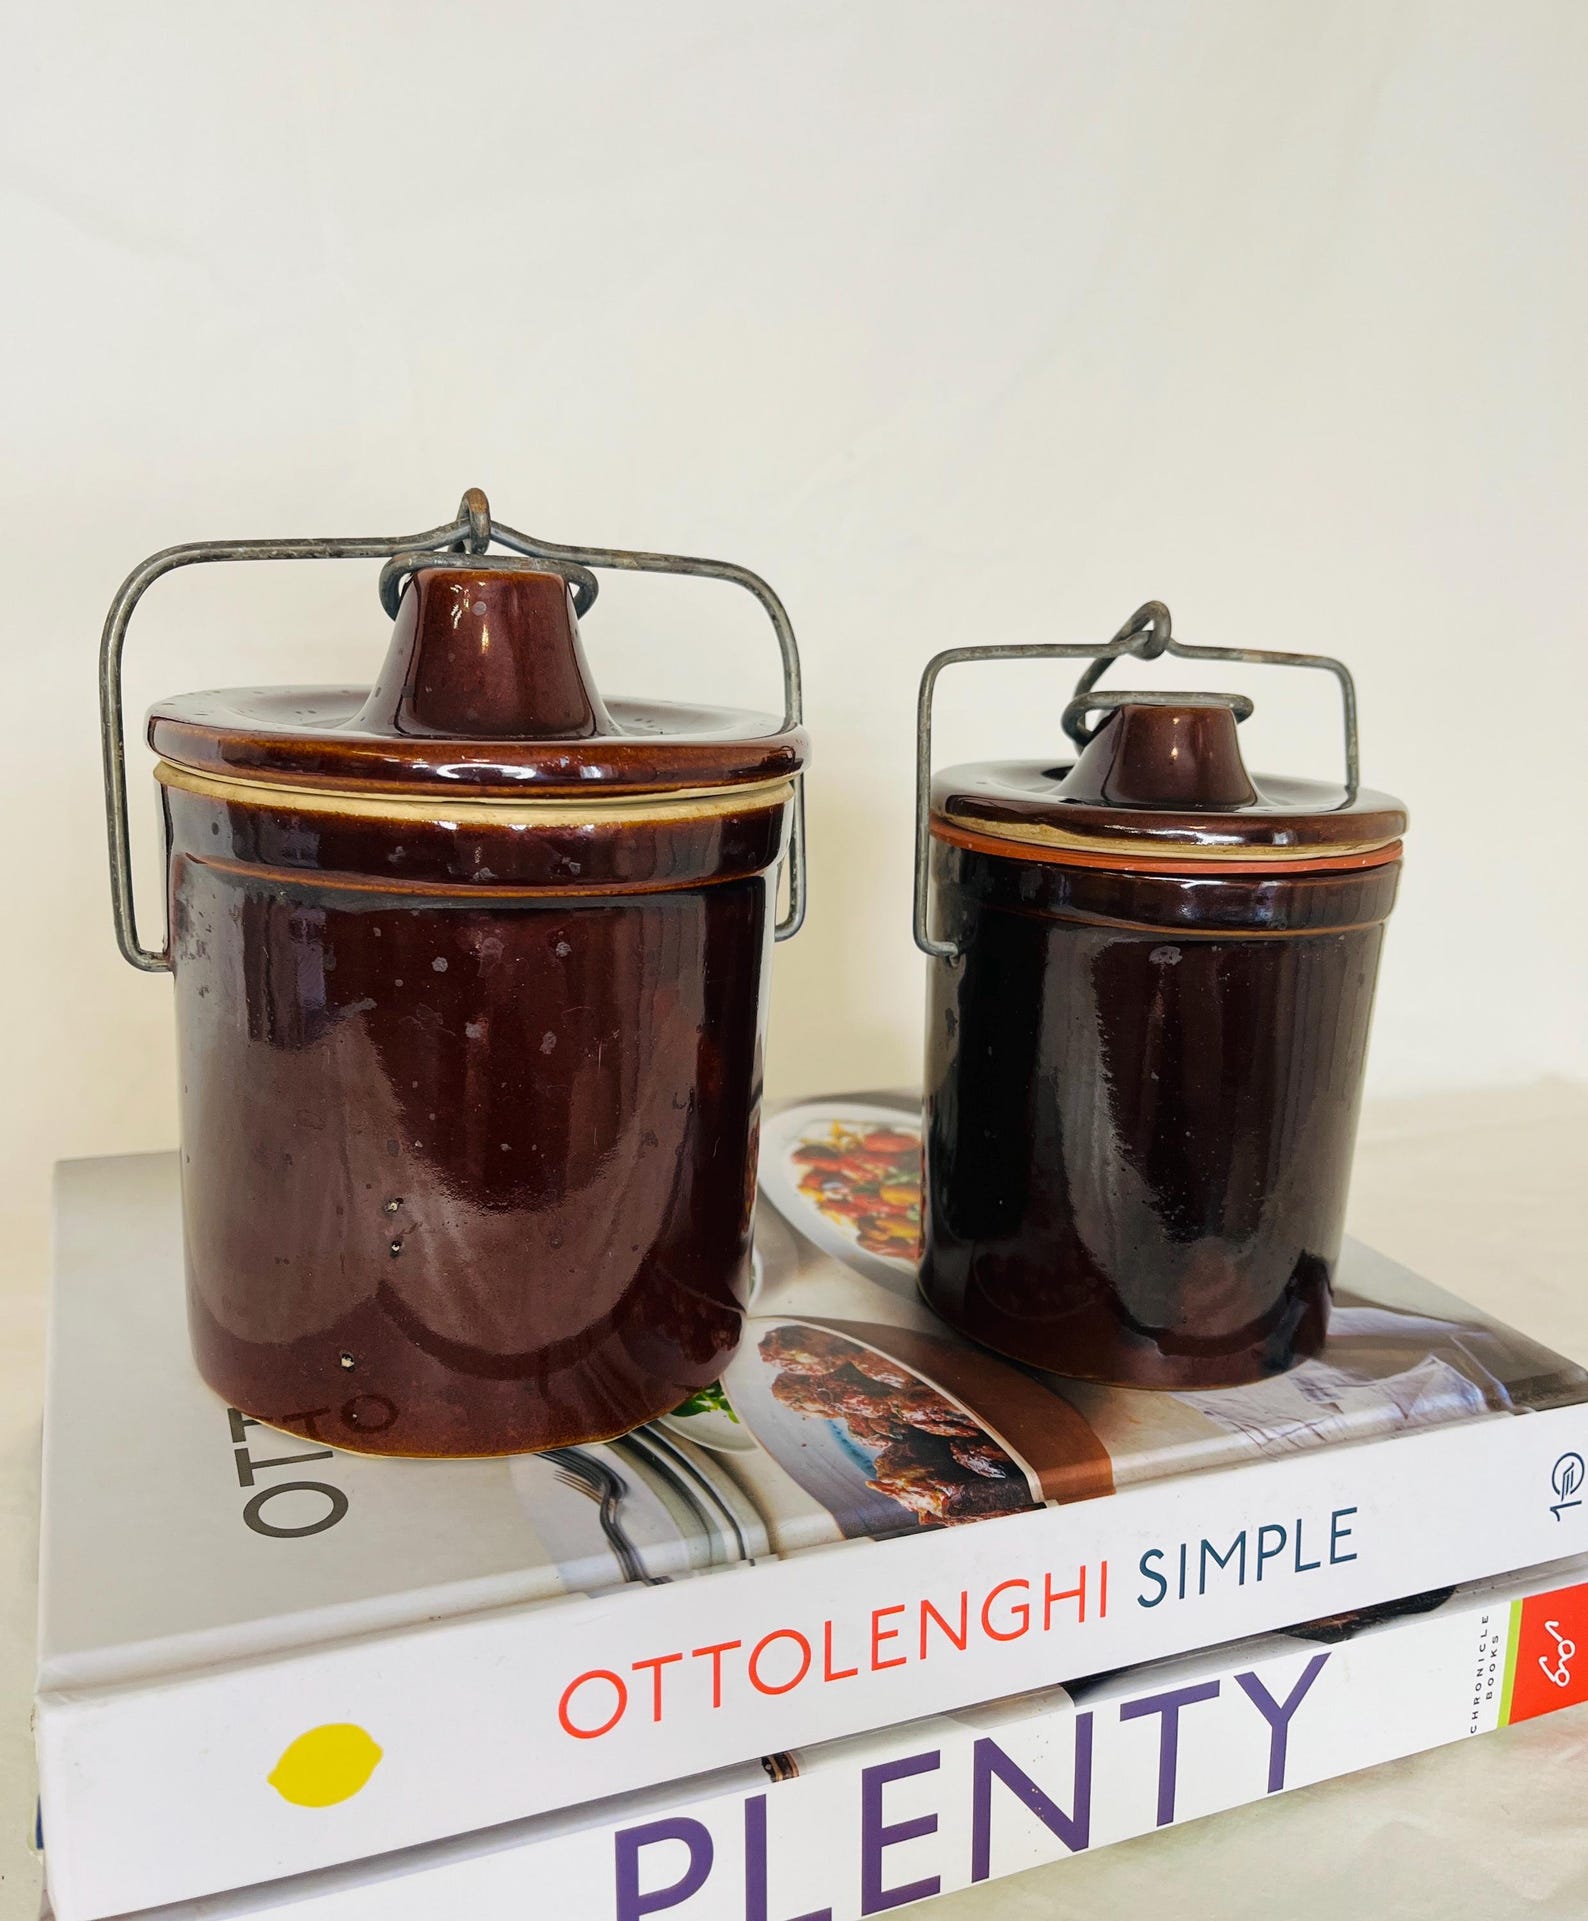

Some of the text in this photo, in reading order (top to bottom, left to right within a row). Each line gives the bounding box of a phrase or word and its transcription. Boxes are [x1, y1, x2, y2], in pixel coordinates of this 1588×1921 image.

[556, 1506, 1358, 1741] OTTOLENGHI SIMPLE
[1470, 1615, 1489, 1734] CHRONICLE
[1485, 1635, 1499, 1700] BOOKS
[615, 1653, 1329, 1921] PLENTY
